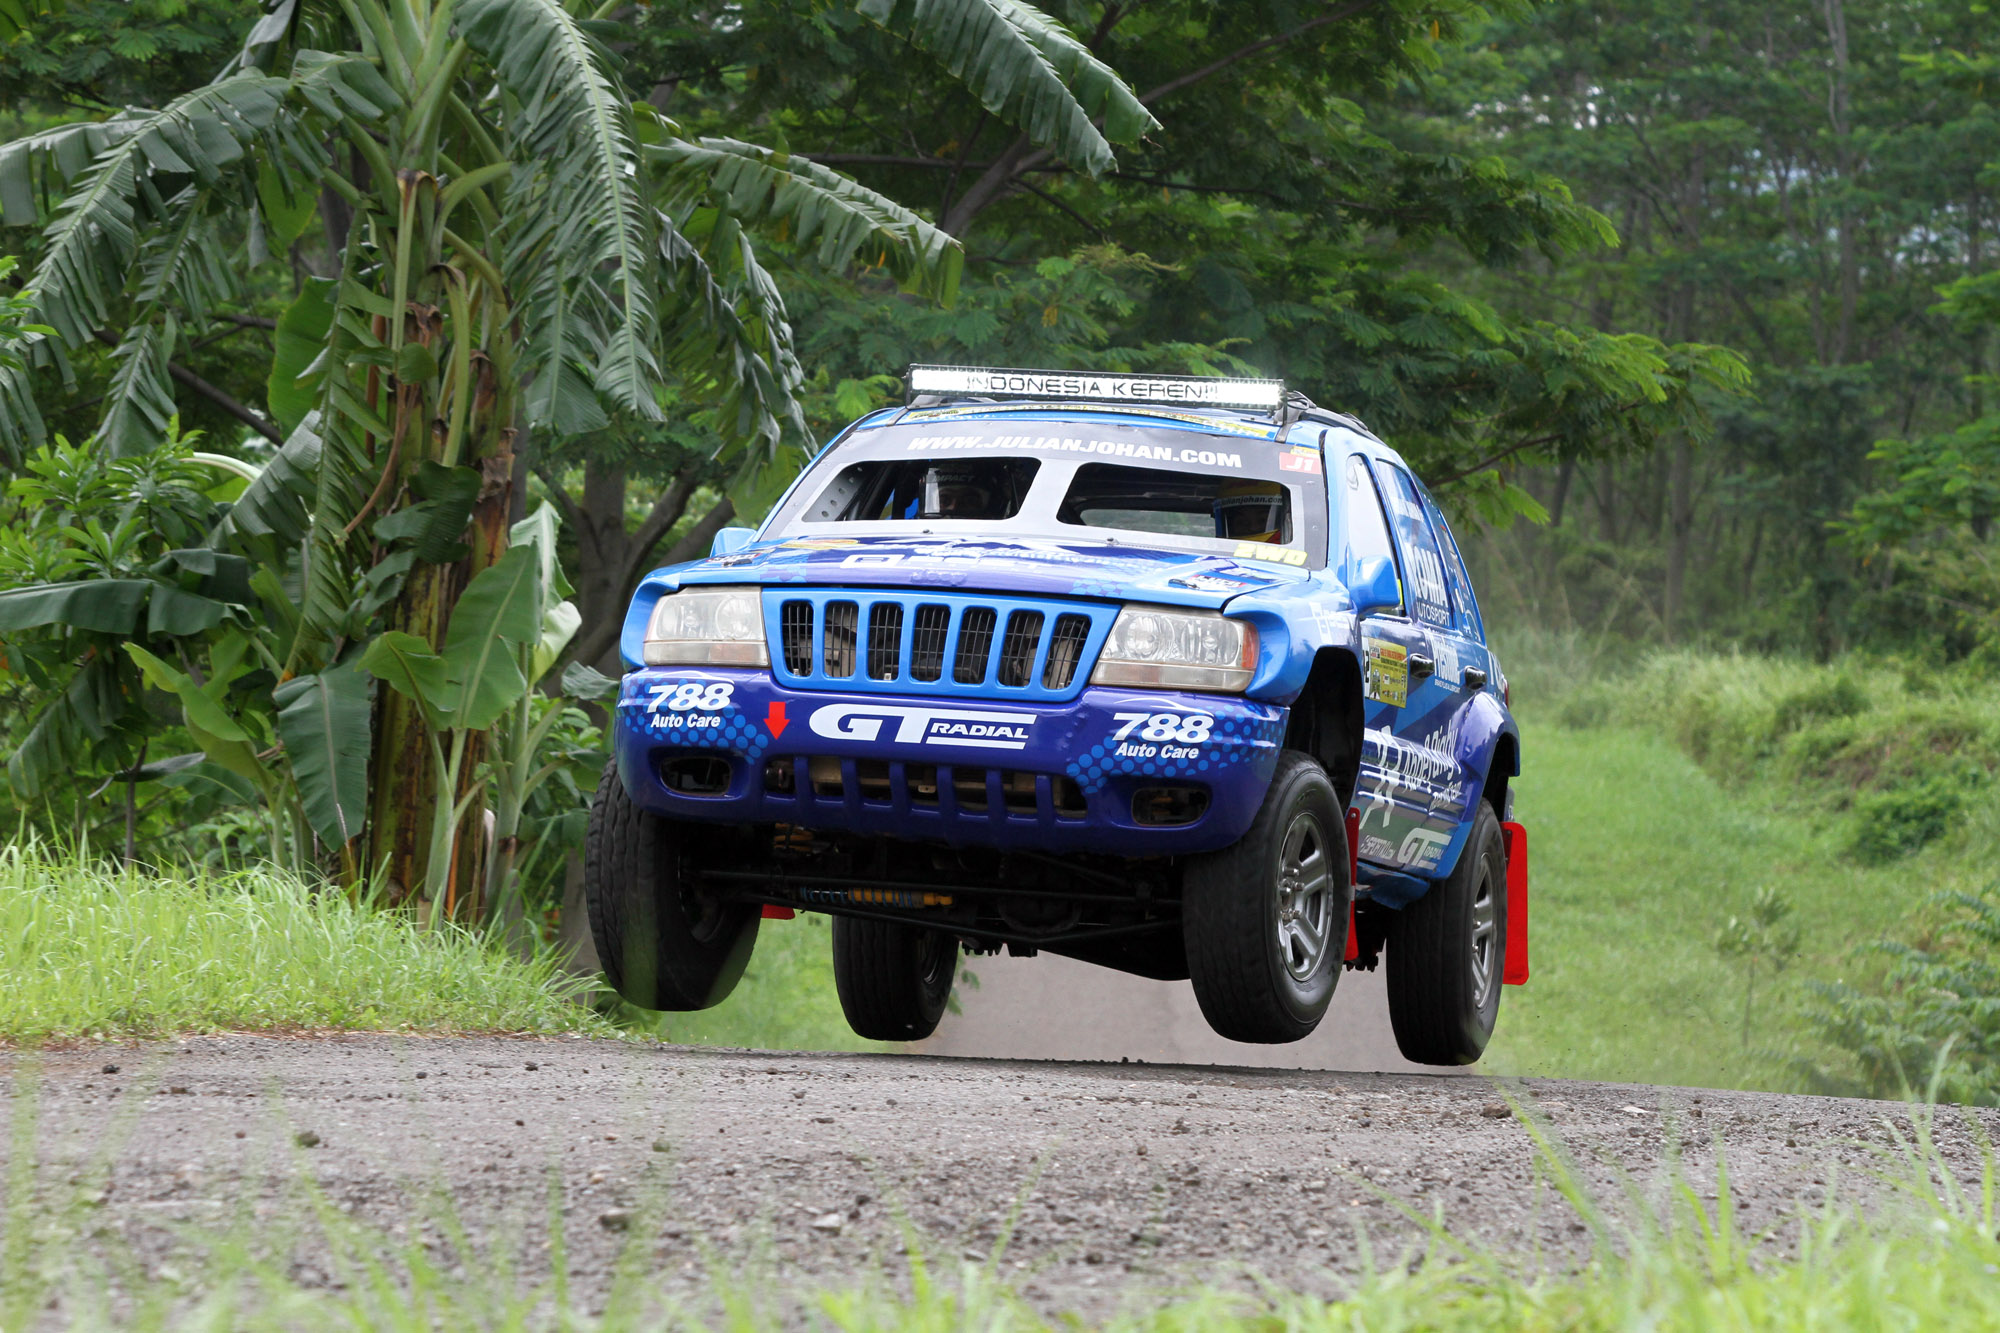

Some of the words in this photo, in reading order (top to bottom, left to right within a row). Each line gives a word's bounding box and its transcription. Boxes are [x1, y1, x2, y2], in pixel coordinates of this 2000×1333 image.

[966, 375, 1102, 394] INDONESIA
[907, 436, 1243, 468] WWW.JULIANJOHAN.COM
[1233, 542, 1308, 566] 2WD
[646, 682, 735, 714] 788
[650, 713, 684, 728] Auto
[686, 713, 721, 728] Care
[930, 722, 1029, 739] RADIAL
[1112, 712, 1215, 744] 788
[1115, 742, 1157, 758] Auto
[1160, 744, 1200, 759] Care
[1397, 827, 1453, 867] GT
